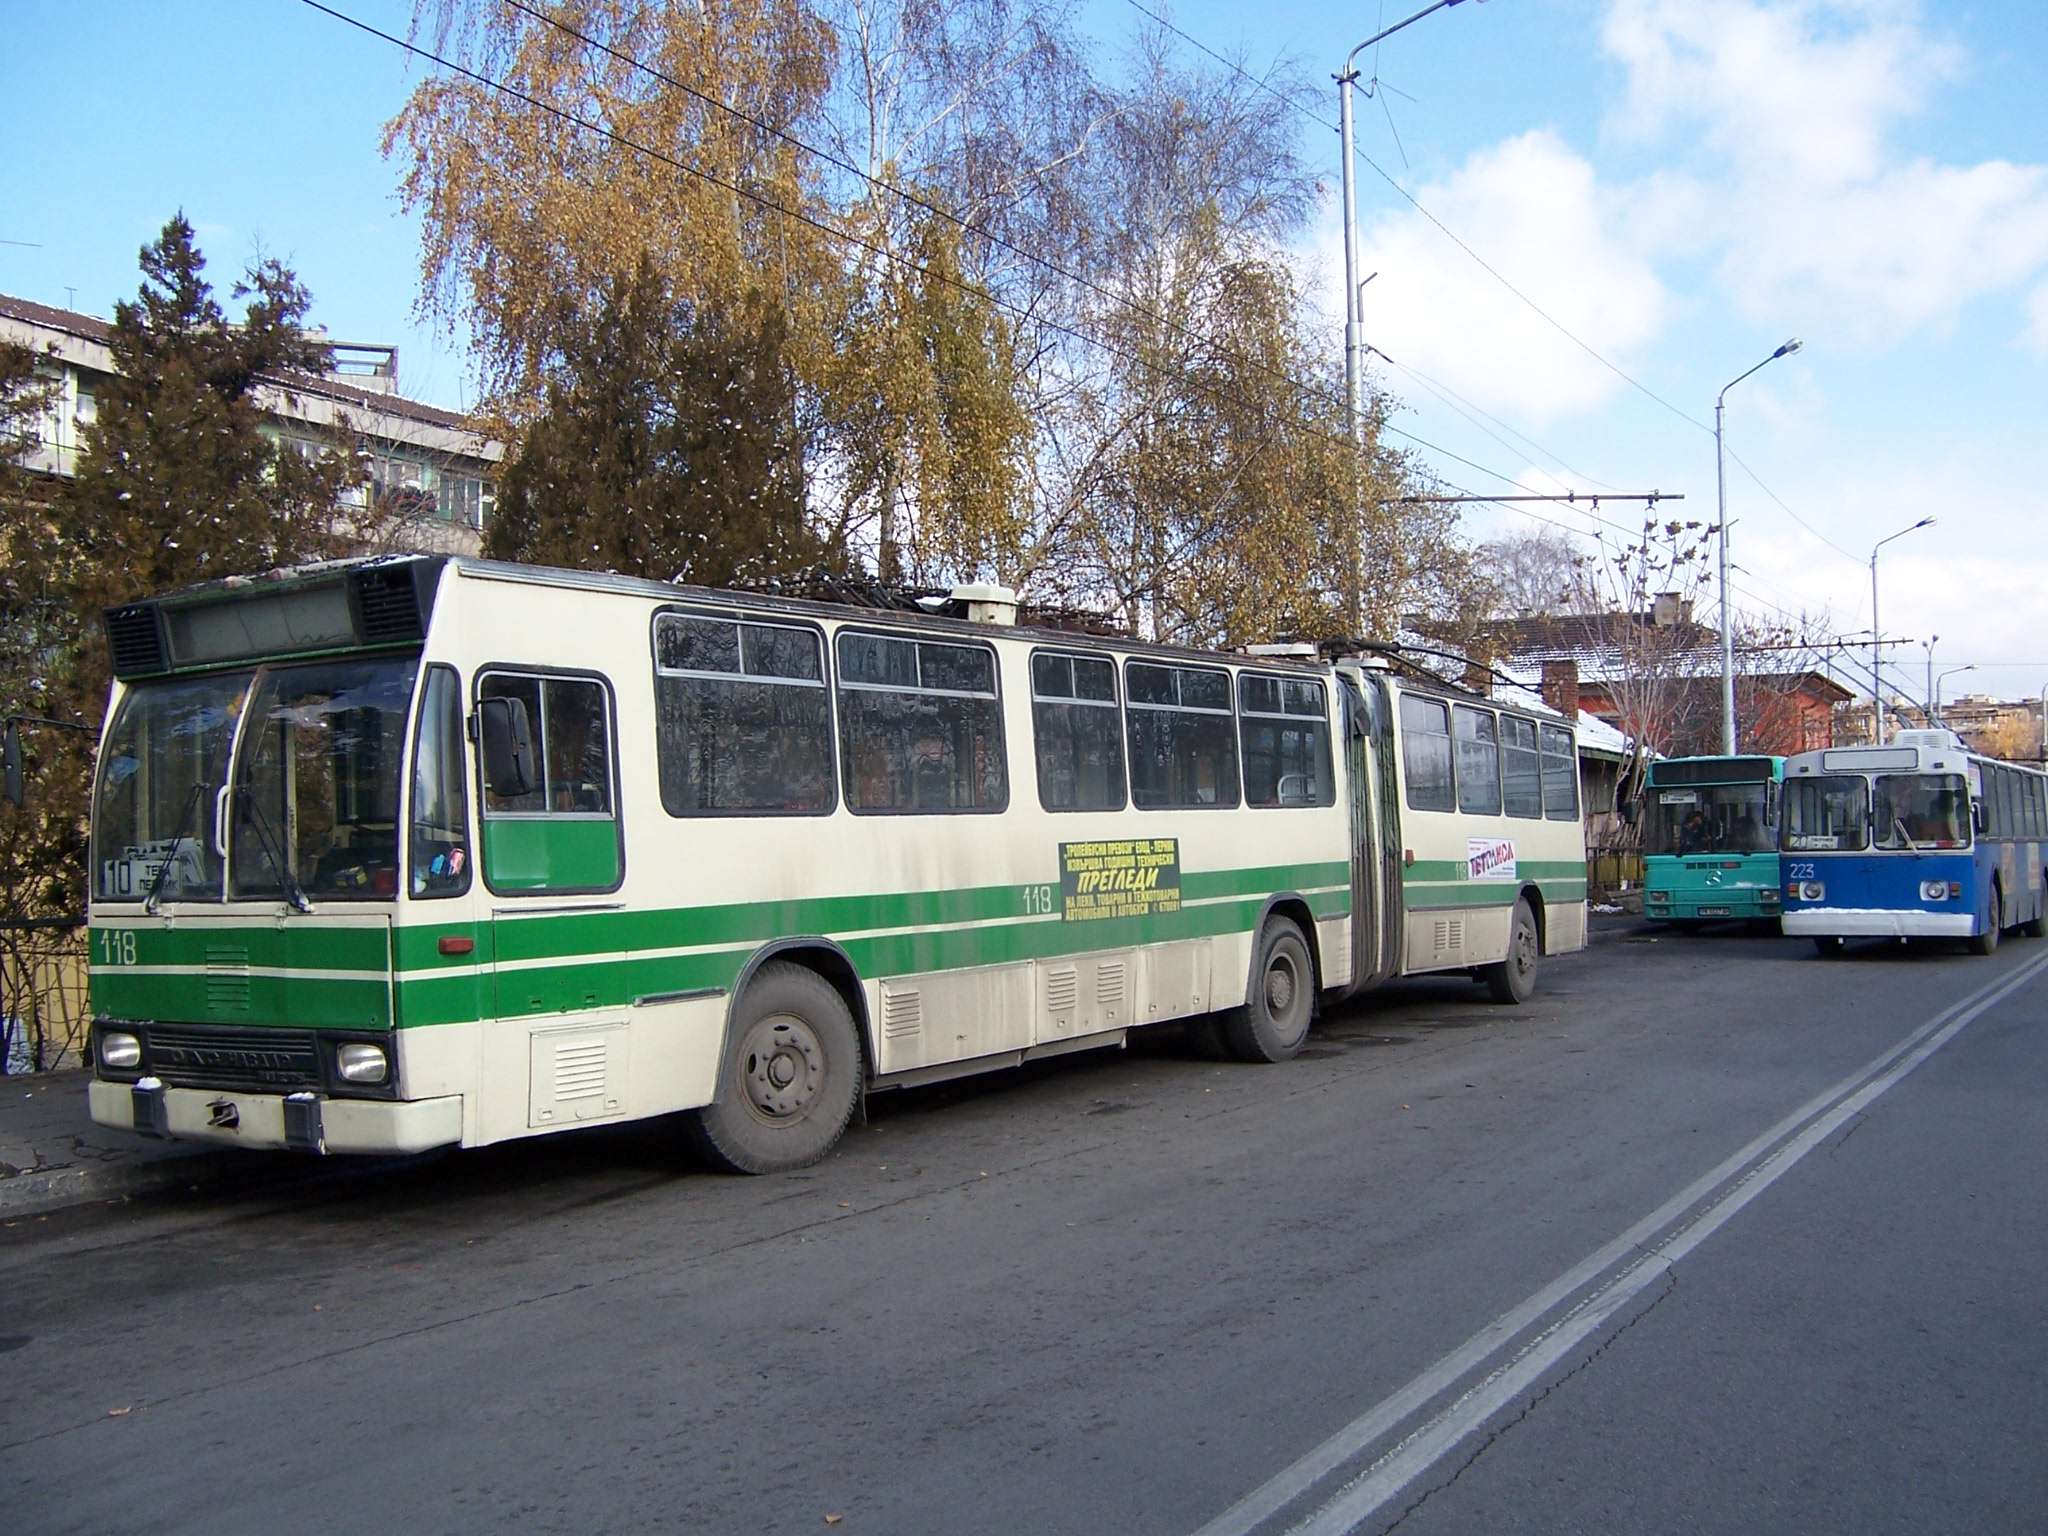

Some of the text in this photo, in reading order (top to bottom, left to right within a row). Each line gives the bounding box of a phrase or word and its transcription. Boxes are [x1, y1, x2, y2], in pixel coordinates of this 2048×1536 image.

[107, 861, 131, 894] 10
[1077, 867, 1158, 894] ПРЕГЛЕДИ
[1790, 864, 1814, 879] 223
[1023, 886, 1052, 914] 118
[100, 929, 136, 965] 118
